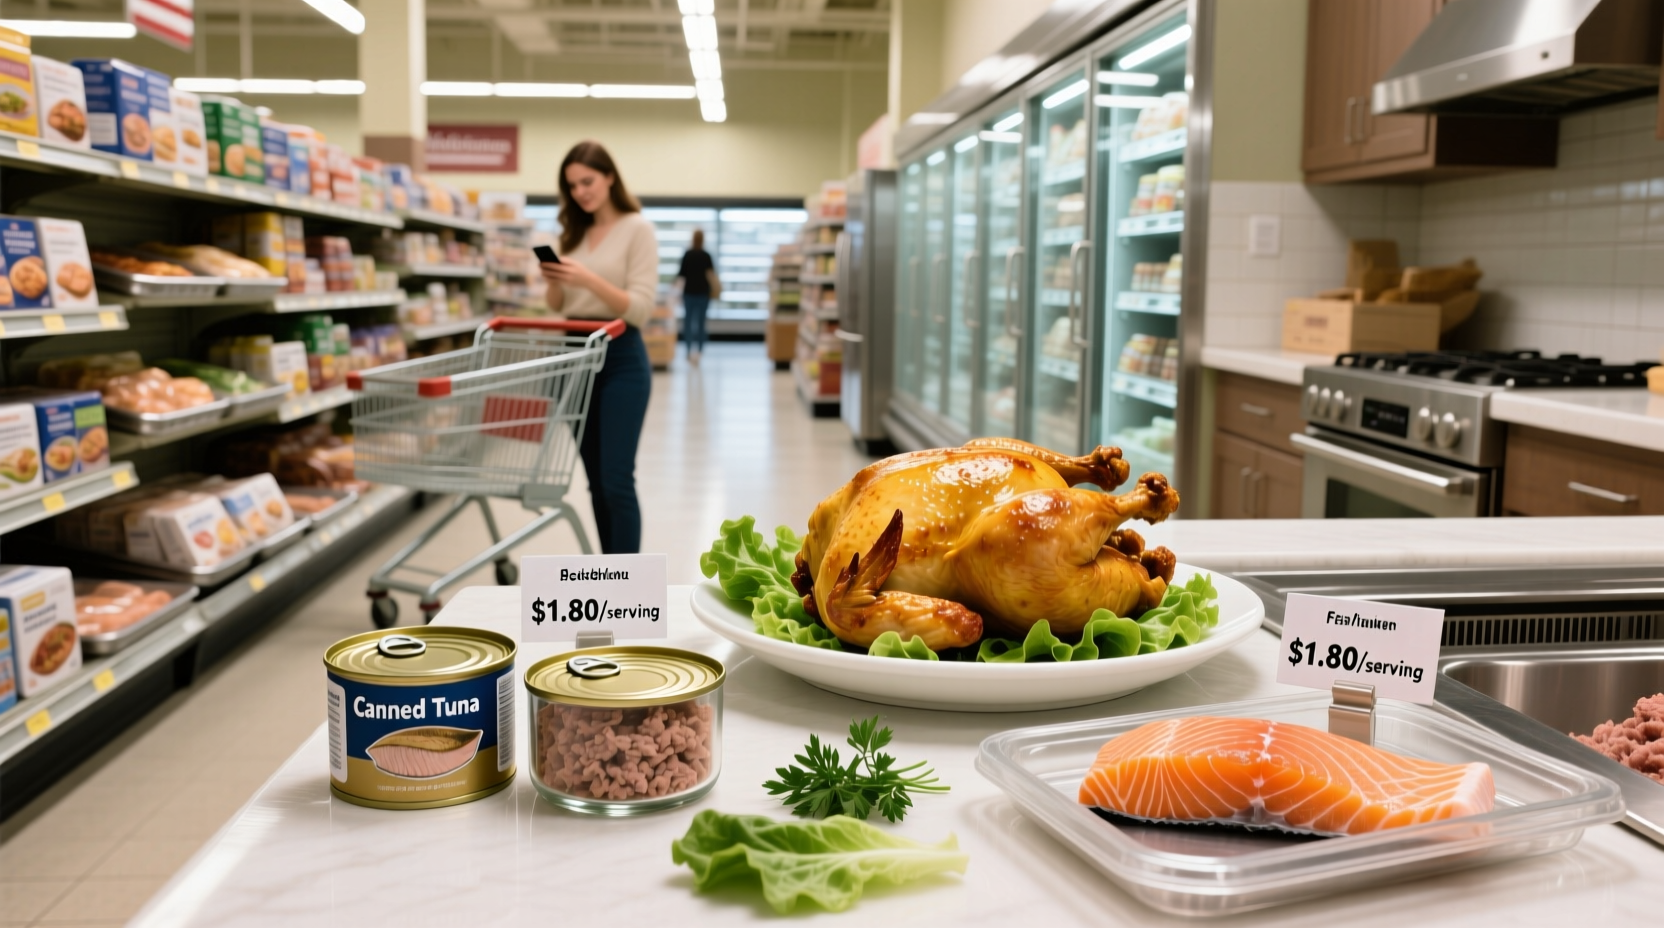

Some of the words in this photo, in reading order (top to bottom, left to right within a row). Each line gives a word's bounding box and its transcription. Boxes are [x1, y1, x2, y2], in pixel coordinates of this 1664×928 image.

[531, 596, 660, 626] $1.80/serving
[1287, 636, 1424, 684] $1.80/serving
[353, 696, 426, 720] Canned
[431, 696, 480, 718] Tuna
